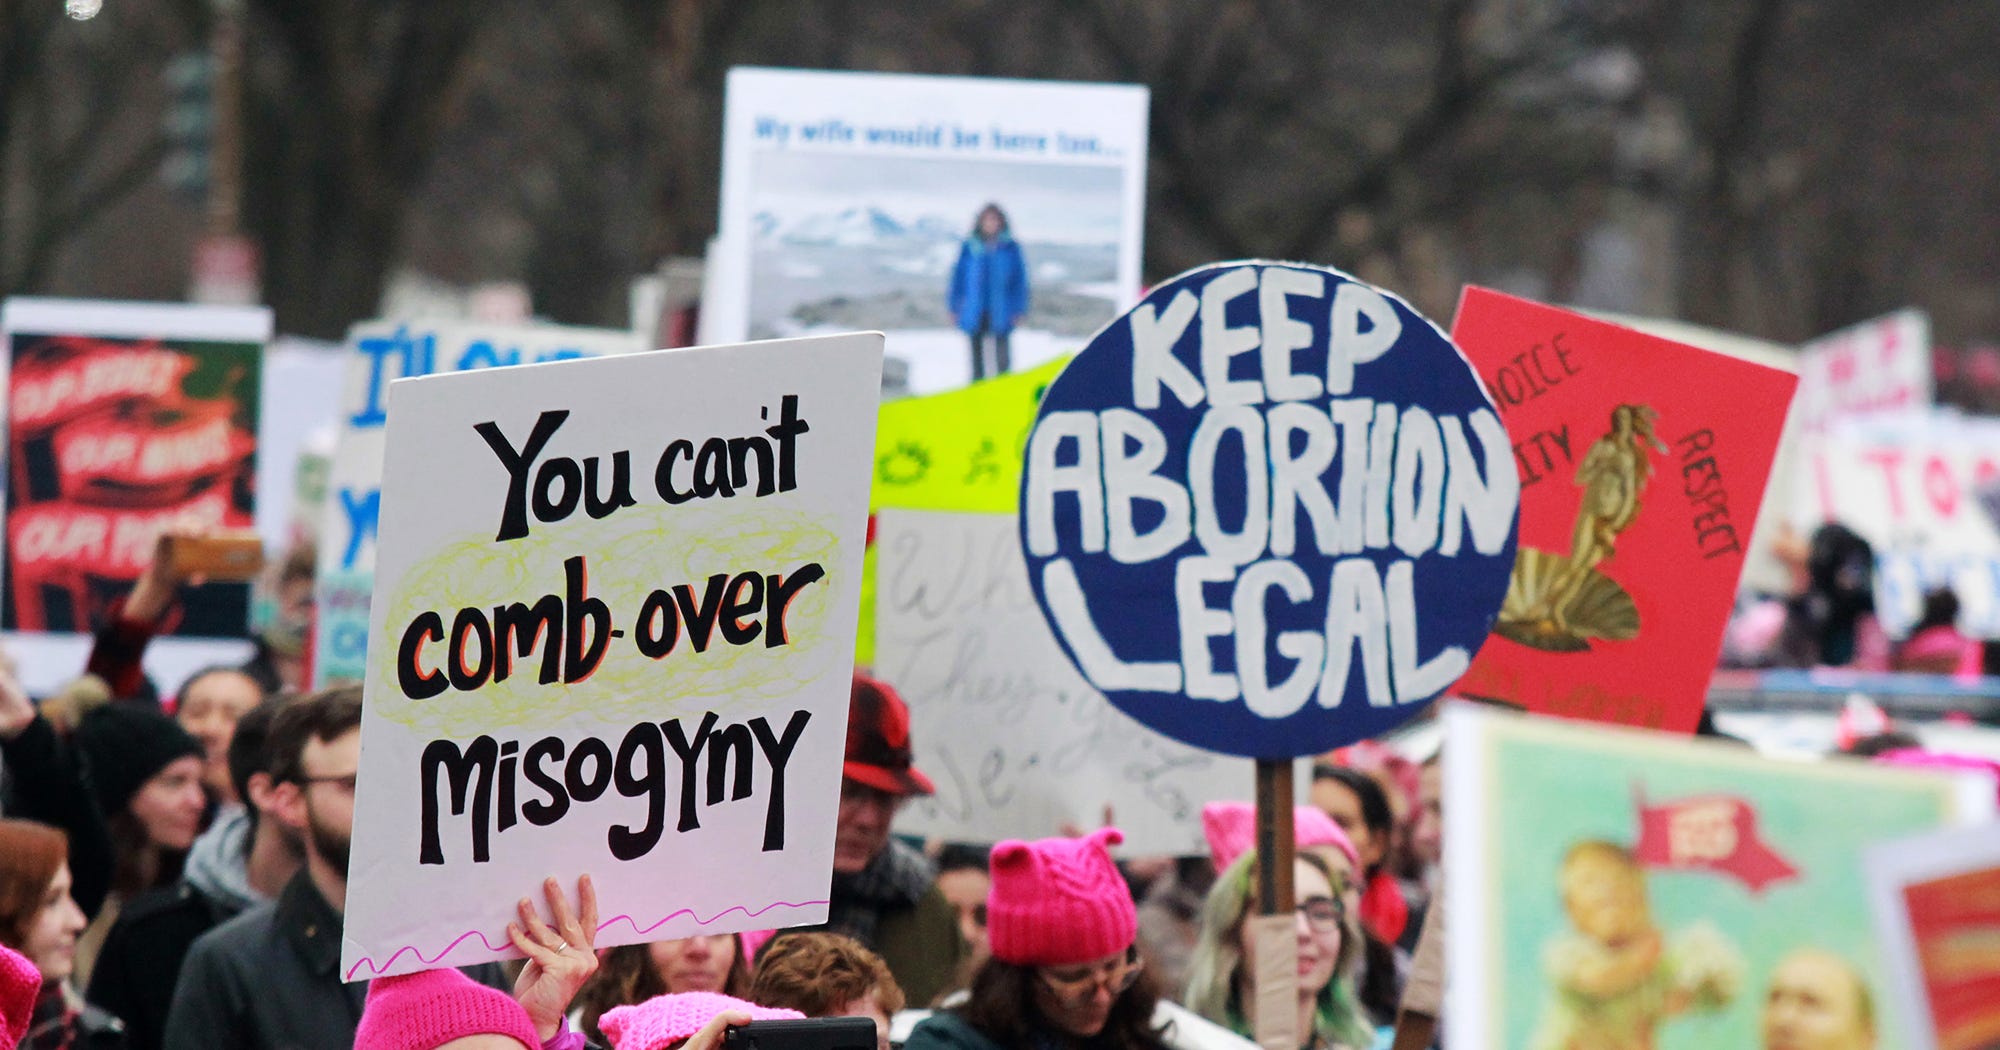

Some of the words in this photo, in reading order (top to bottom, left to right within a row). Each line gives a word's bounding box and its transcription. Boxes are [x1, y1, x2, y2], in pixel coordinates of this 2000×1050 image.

[1130, 266, 1401, 410] KEEP
[1487, 333, 1583, 412] OICE
[473, 409, 637, 541] You
[655, 395, 810, 504] can't
[1026, 398, 1521, 564] ABORTION
[1677, 428, 1742, 559] RESPECT
[1043, 556, 1471, 719] LEGAL
